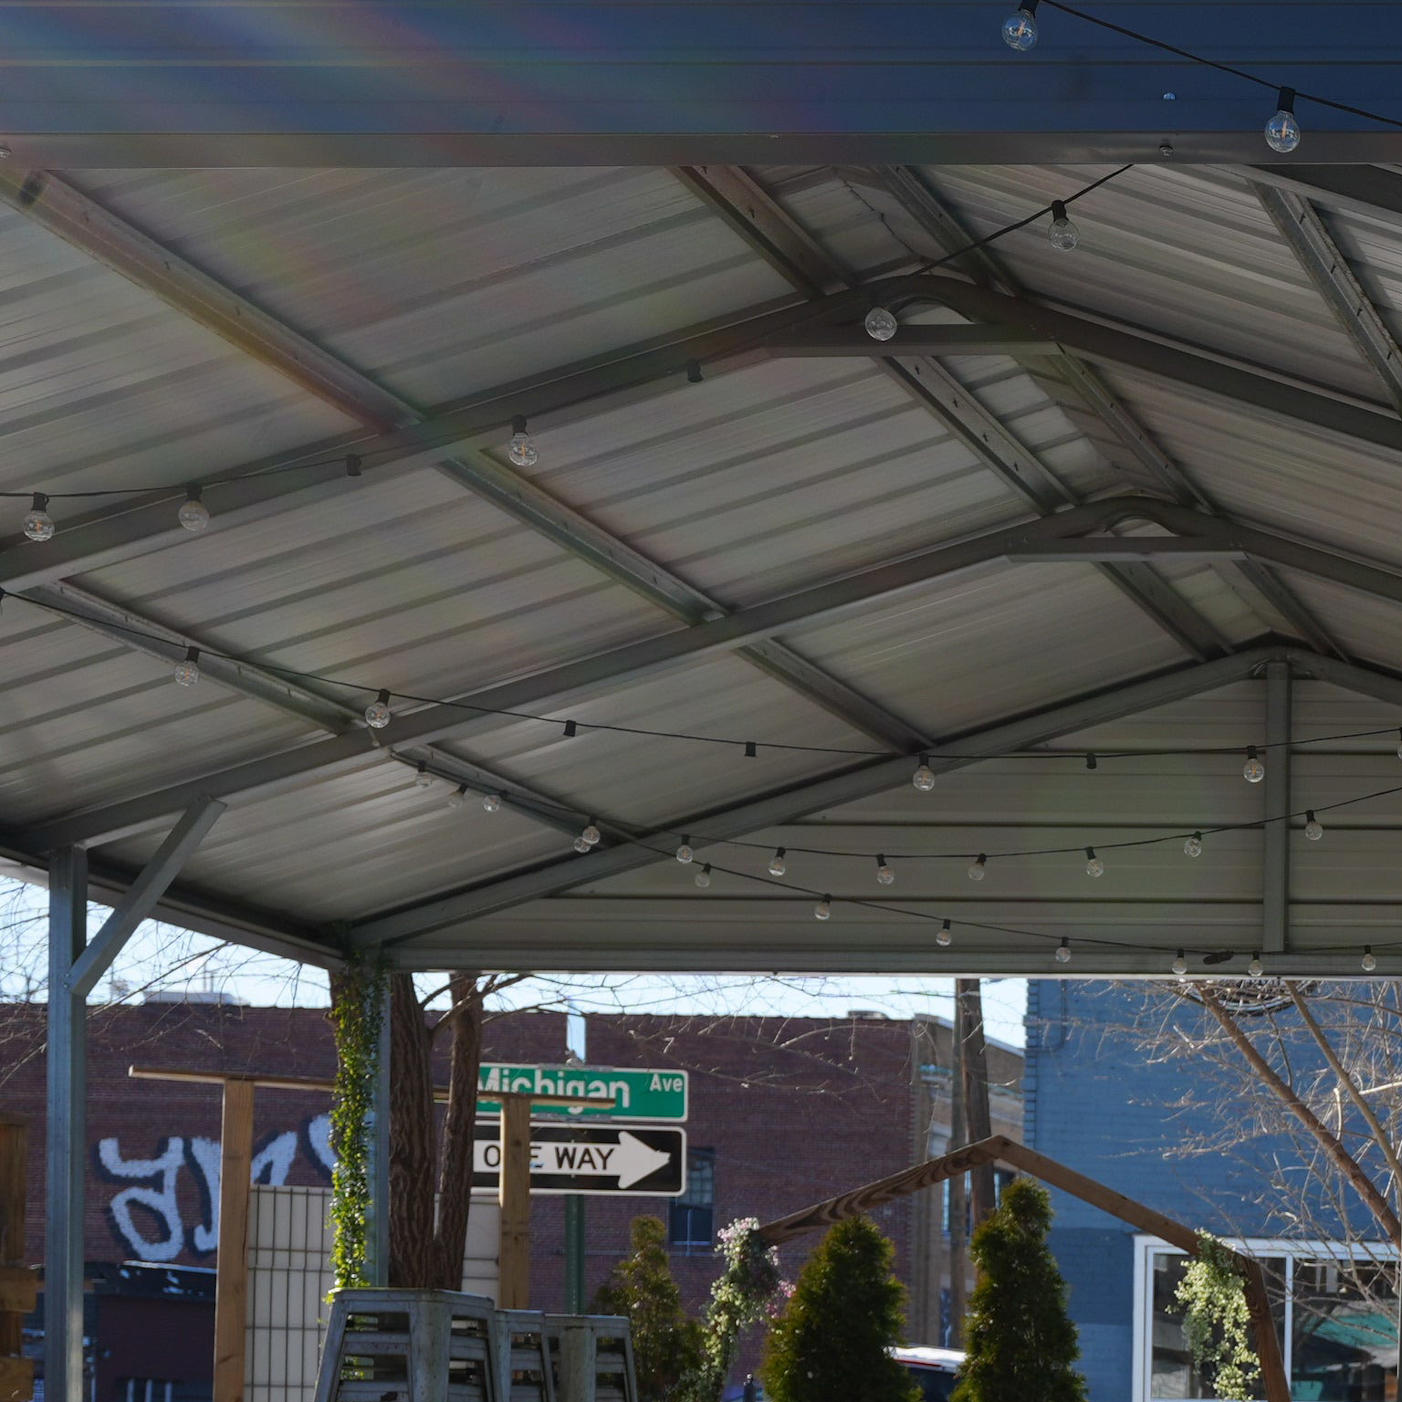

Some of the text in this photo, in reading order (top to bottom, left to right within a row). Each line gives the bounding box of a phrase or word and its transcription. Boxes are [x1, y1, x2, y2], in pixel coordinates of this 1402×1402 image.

[477, 1067, 683, 1115] Michigan Ave
[483, 1145, 614, 1170] OE WAY
